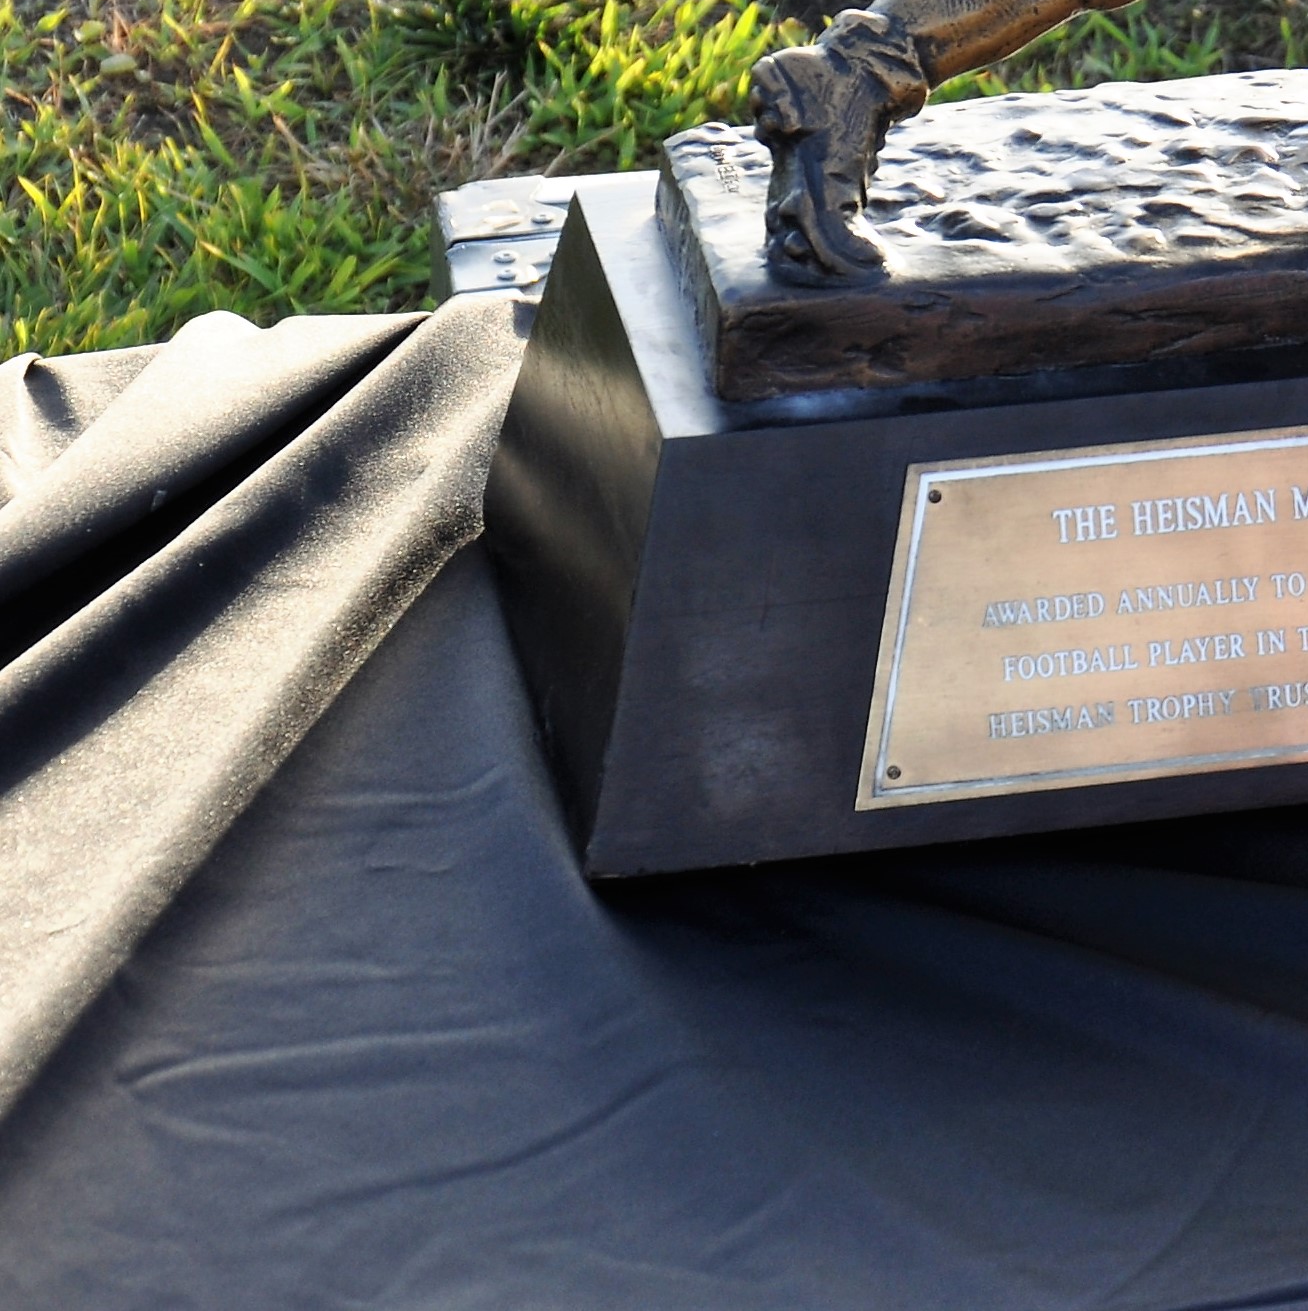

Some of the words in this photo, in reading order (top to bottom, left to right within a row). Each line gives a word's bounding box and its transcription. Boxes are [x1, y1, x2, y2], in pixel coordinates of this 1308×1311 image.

[1052, 505, 1118, 544] THE
[1130, 489, 1277, 536] HEISMAN
[982, 592, 1105, 628] AWARDED
[1117, 576, 1259, 614] ANNUALLY
[1271, 572, 1306, 598] TO
[1003, 645, 1138, 682] FOOTBALL
[1149, 633, 1245, 667] PLAYER
[1256, 629, 1286, 655] IN
[987, 701, 1115, 738] HEISMAN
[1127, 689, 1236, 724] TROPHY
